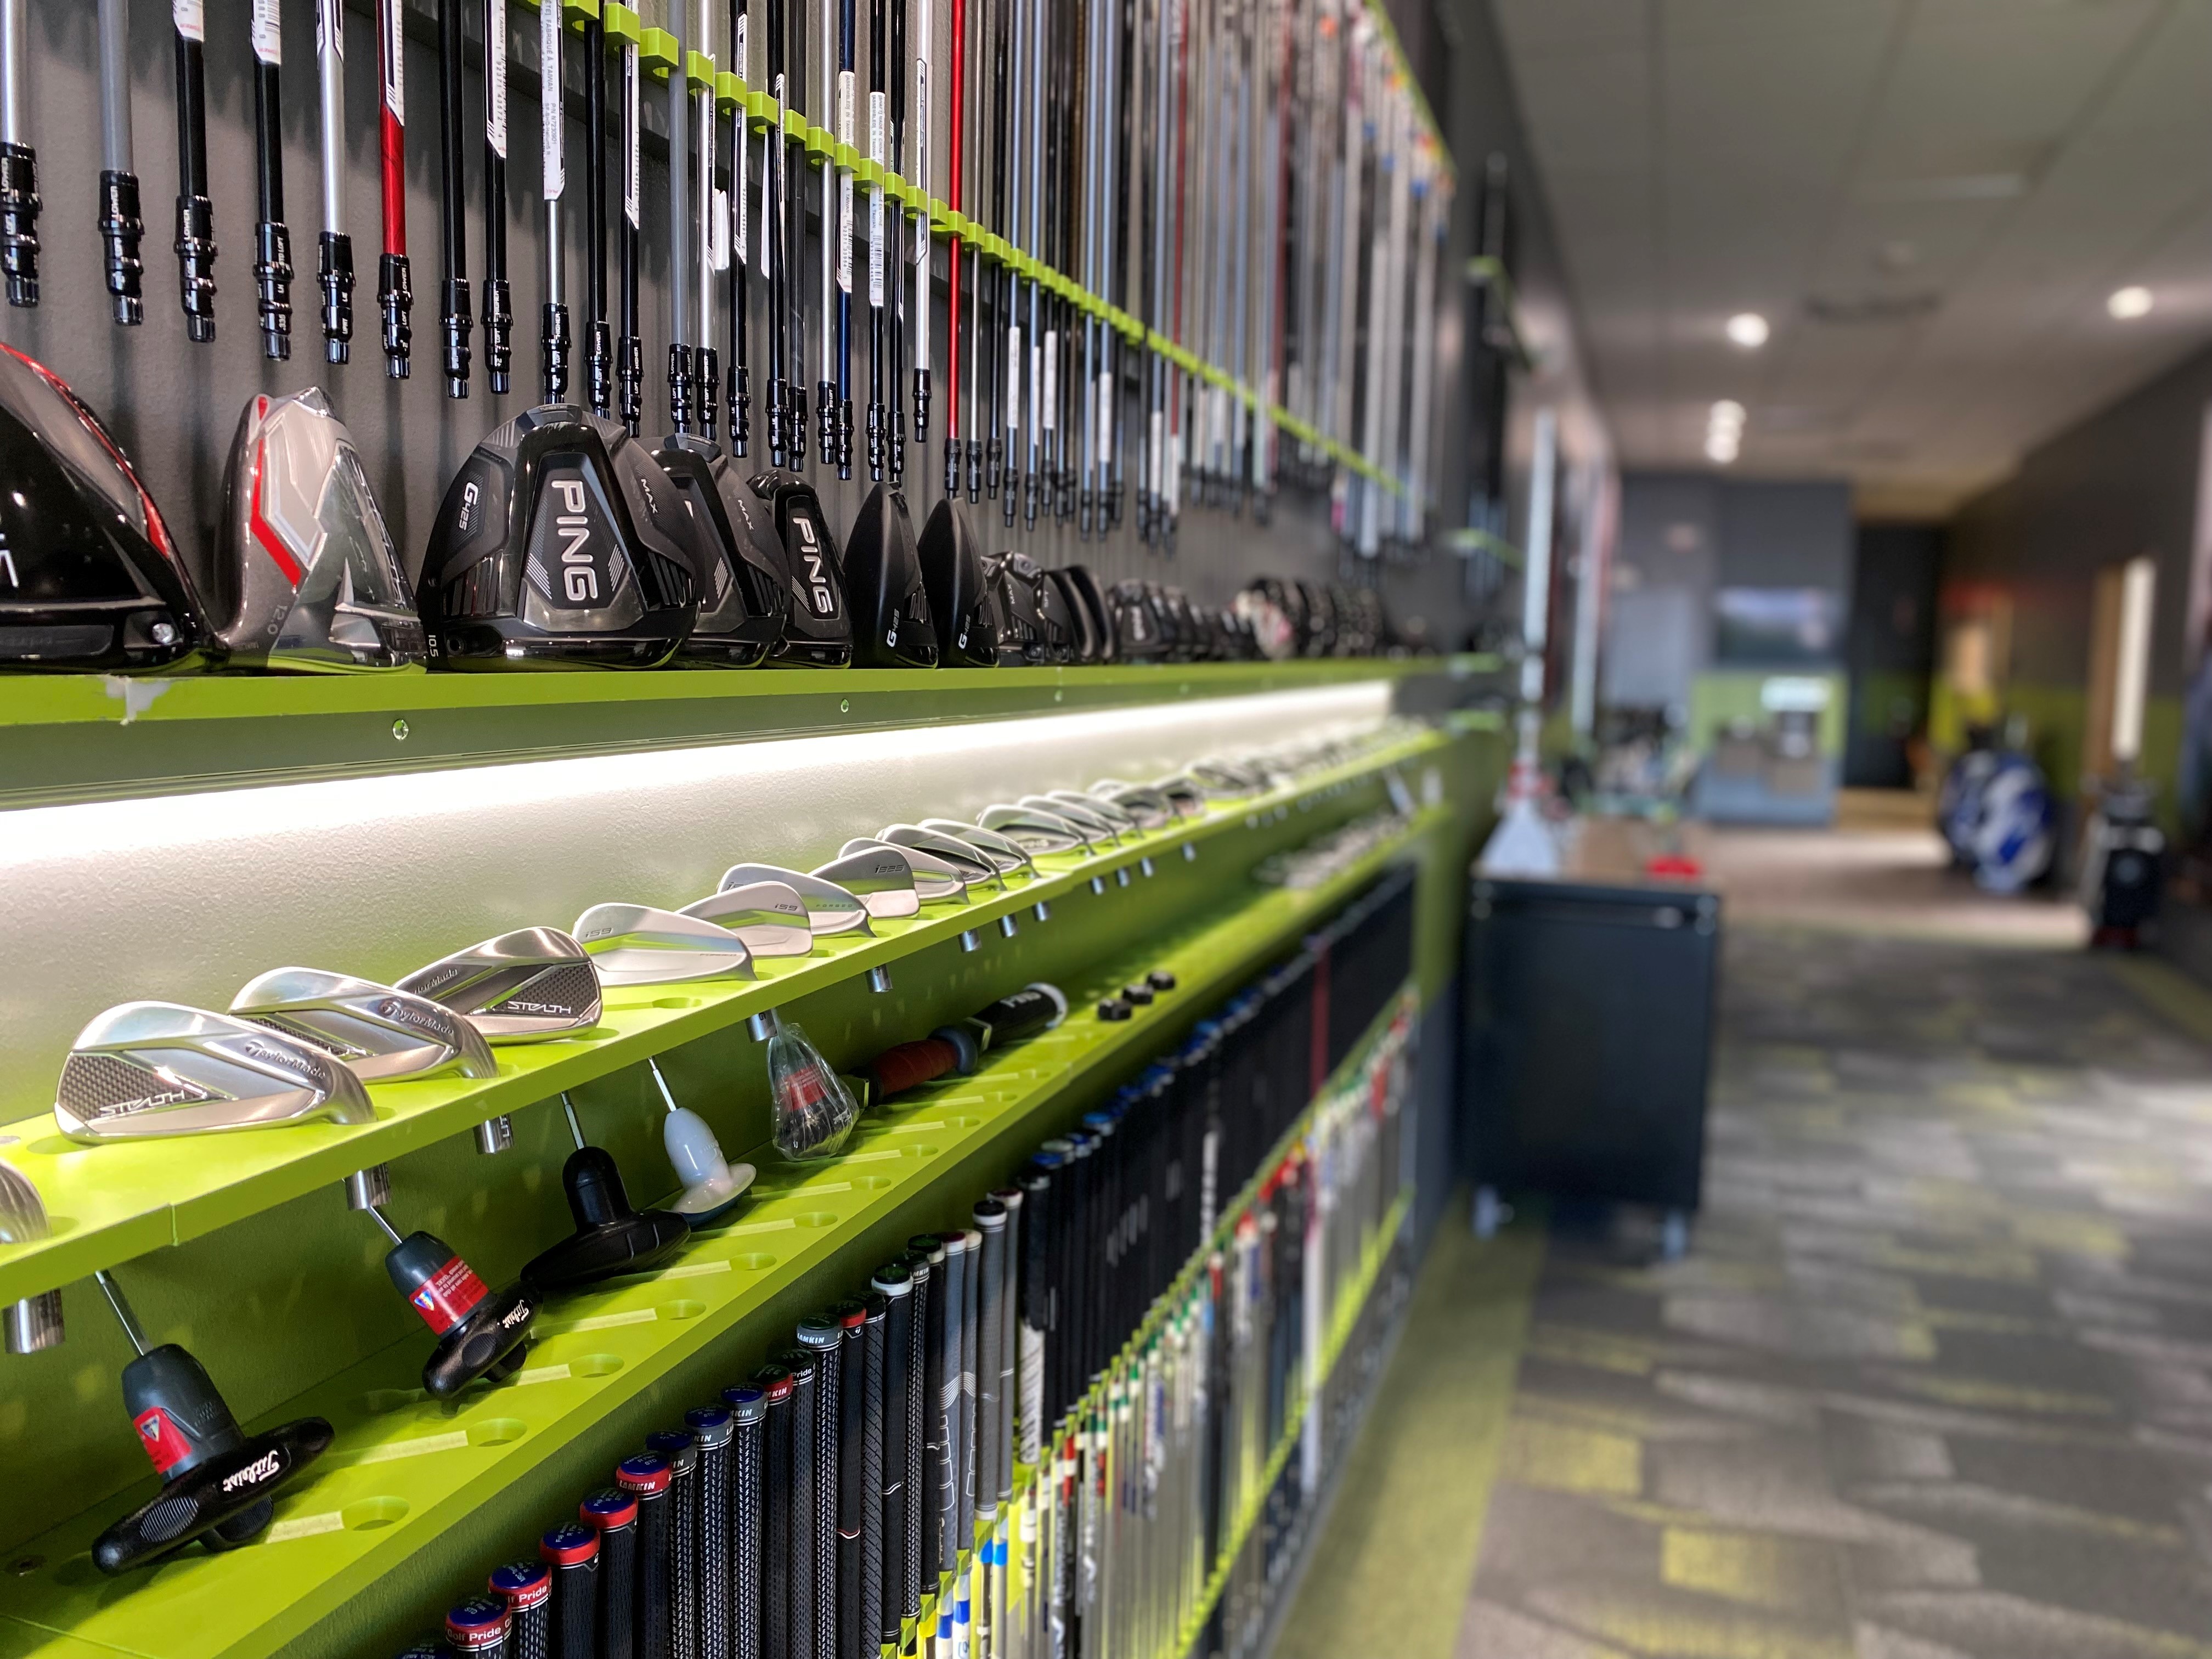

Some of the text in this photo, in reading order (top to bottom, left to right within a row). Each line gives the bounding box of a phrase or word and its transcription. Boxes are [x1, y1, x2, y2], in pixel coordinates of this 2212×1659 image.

[111, 186, 119, 218] LOWER
[459, 482, 479, 531] G425
[641, 478, 658, 514] MAX
[738, 499, 754, 530] MAX
[551, 479, 598, 601] PING
[793, 517, 833, 613] PING
[887, 608, 900, 647] G425
[958, 614, 971, 649] G425
[428, 635, 439, 657] 10.5
[507, 1000, 572, 1014] STEALTH
[245, 1039, 326, 1079] TaylorMade
[100, 1090, 185, 1118] STEALTH
[913, 1267, 929, 1277] MKIN
[503, 1299, 529, 1328] Titleist
[797, 1333, 825, 1344] LAMKIN
[223, 1449, 280, 1492] Titleist
[619, 1480, 656, 1491] LAMKIN
[518, 1585, 548, 1602] Pride
[469, 1627, 501, 1641] Pride
